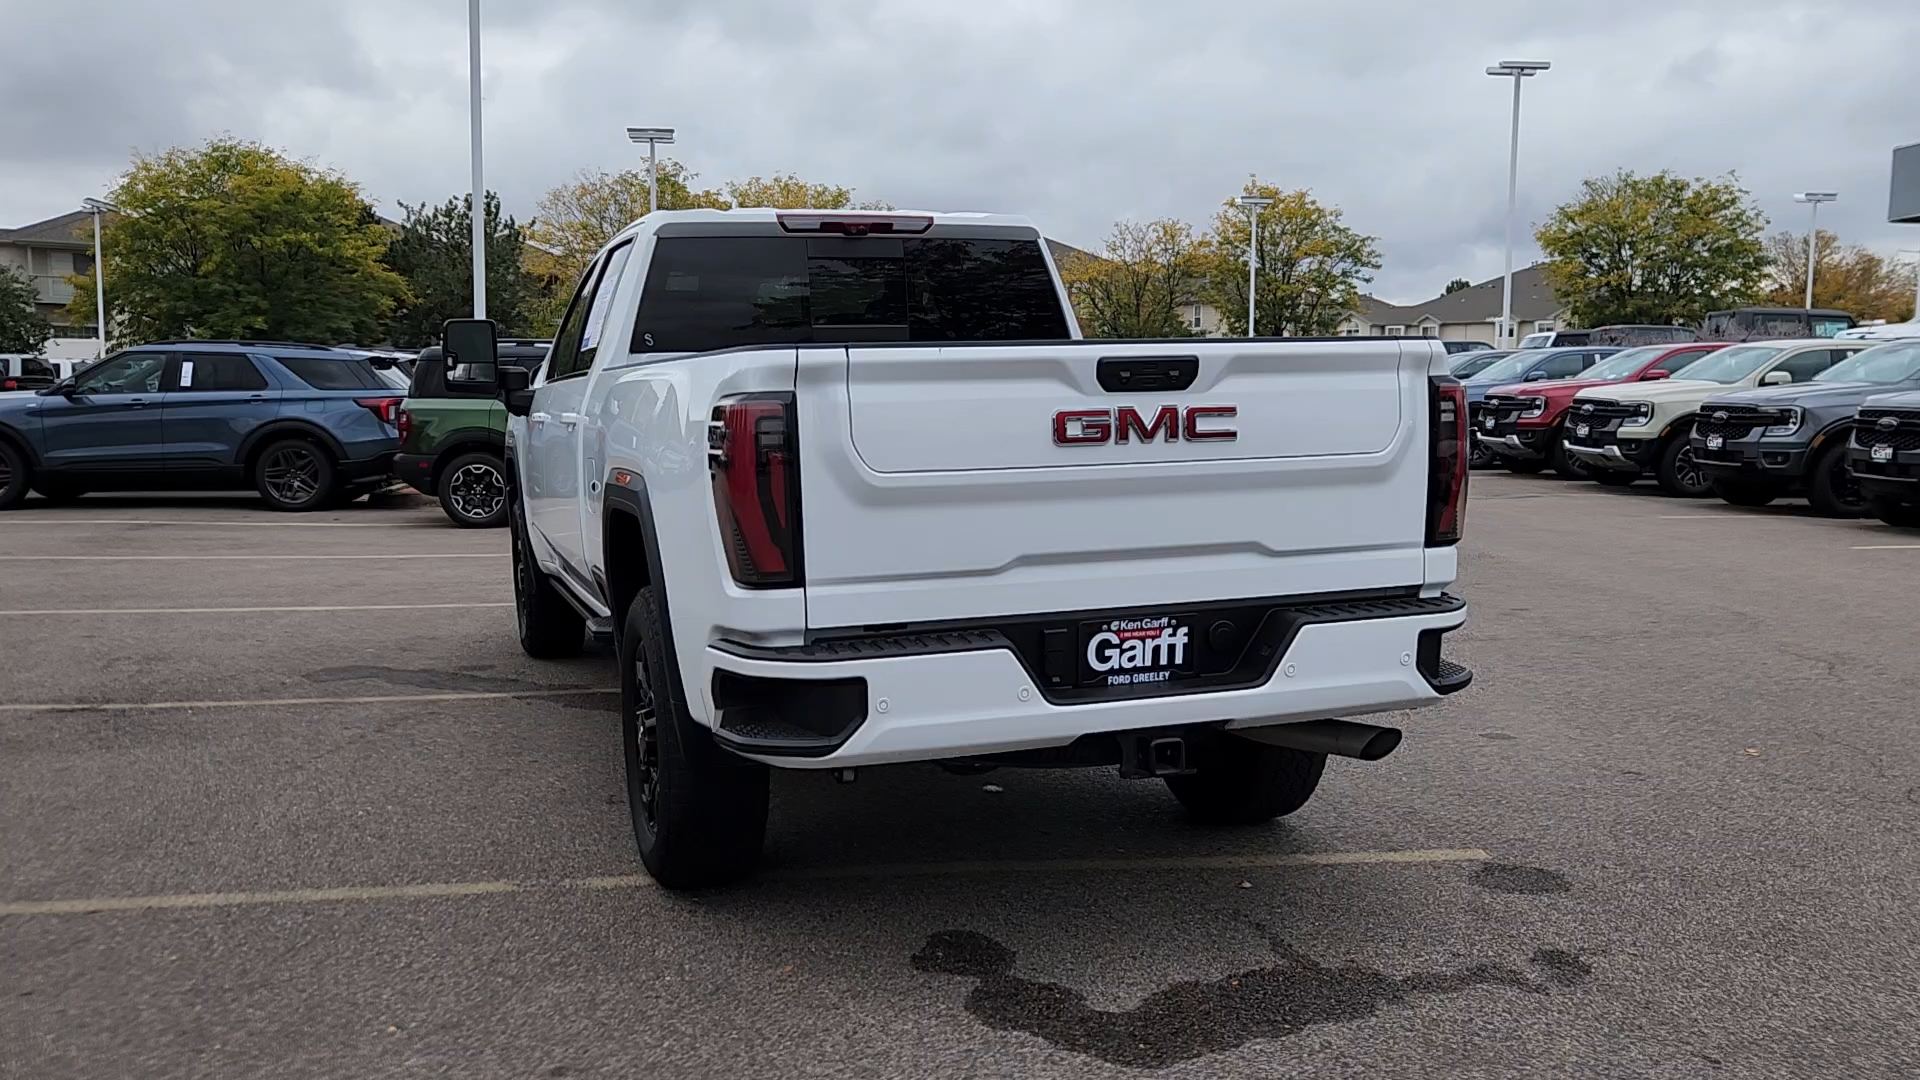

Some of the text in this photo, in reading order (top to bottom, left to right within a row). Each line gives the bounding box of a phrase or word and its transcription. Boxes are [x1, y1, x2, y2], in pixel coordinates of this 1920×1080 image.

[1052, 404, 1237, 447] GMC
[1120, 617, 1168, 630] Ken Garff
[1087, 626, 1188, 671] Garff
[1108, 671, 1170, 685] FORD GREELEY
